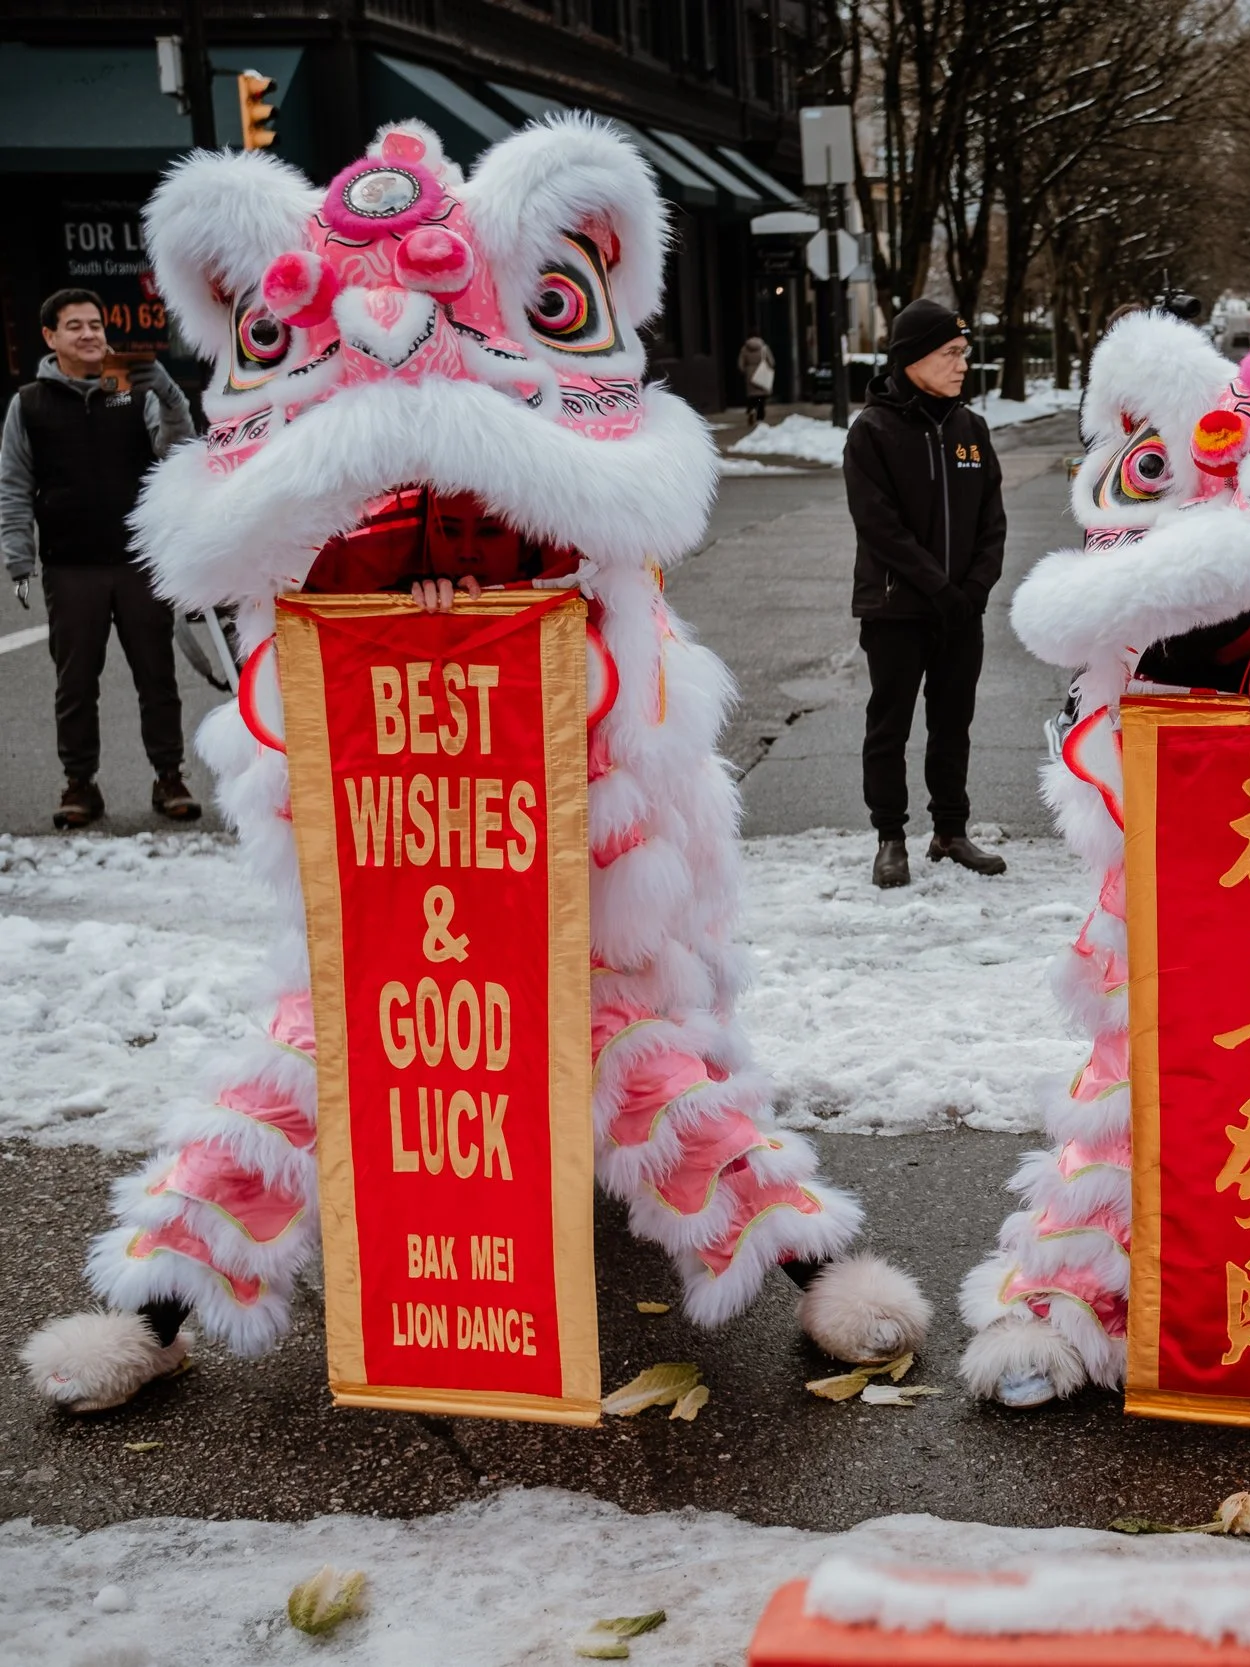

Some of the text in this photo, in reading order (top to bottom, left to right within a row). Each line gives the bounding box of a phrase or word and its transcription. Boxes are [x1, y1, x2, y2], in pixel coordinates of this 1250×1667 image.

[64, 222, 115, 251] FOR
[68, 260, 102, 276] South
[371, 662, 499, 755] BEST
[344, 774, 536, 872] WISHES
[423, 885, 470, 962] &
[379, 977, 510, 1071] GOOD
[390, 1087, 512, 1180] LUCK
[407, 1234, 514, 1282] BAK MEI
[392, 1302, 536, 1355] LION DANCE
